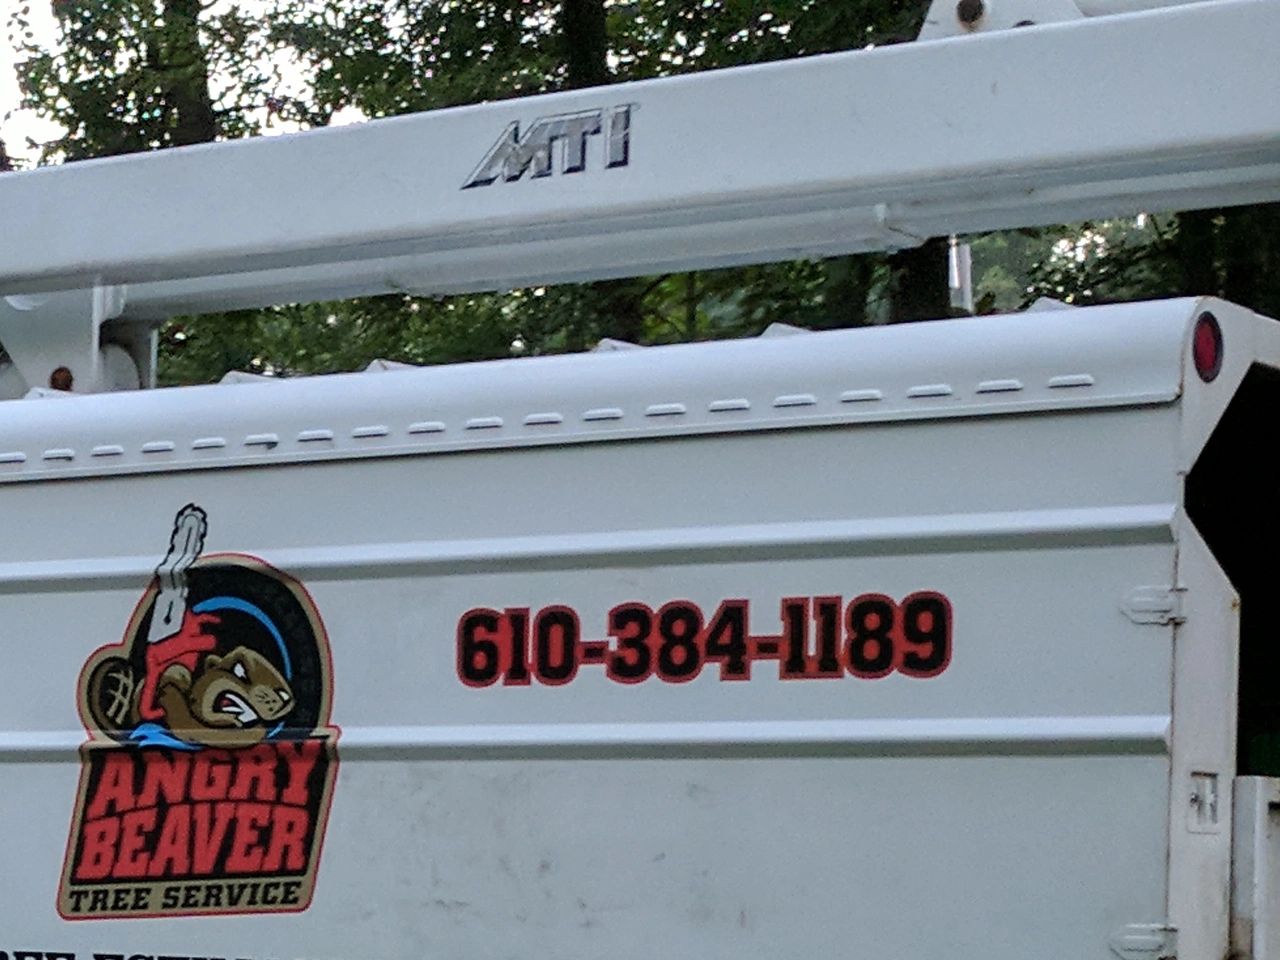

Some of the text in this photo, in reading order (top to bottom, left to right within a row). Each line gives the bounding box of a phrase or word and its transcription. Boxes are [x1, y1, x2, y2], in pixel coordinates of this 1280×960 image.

[456, 590, 953, 688] 610-384-1189
[86, 738, 322, 820] ANGRY
[75, 801, 310, 880] BEAVER
[70, 881, 302, 913] TREE SERVICE
